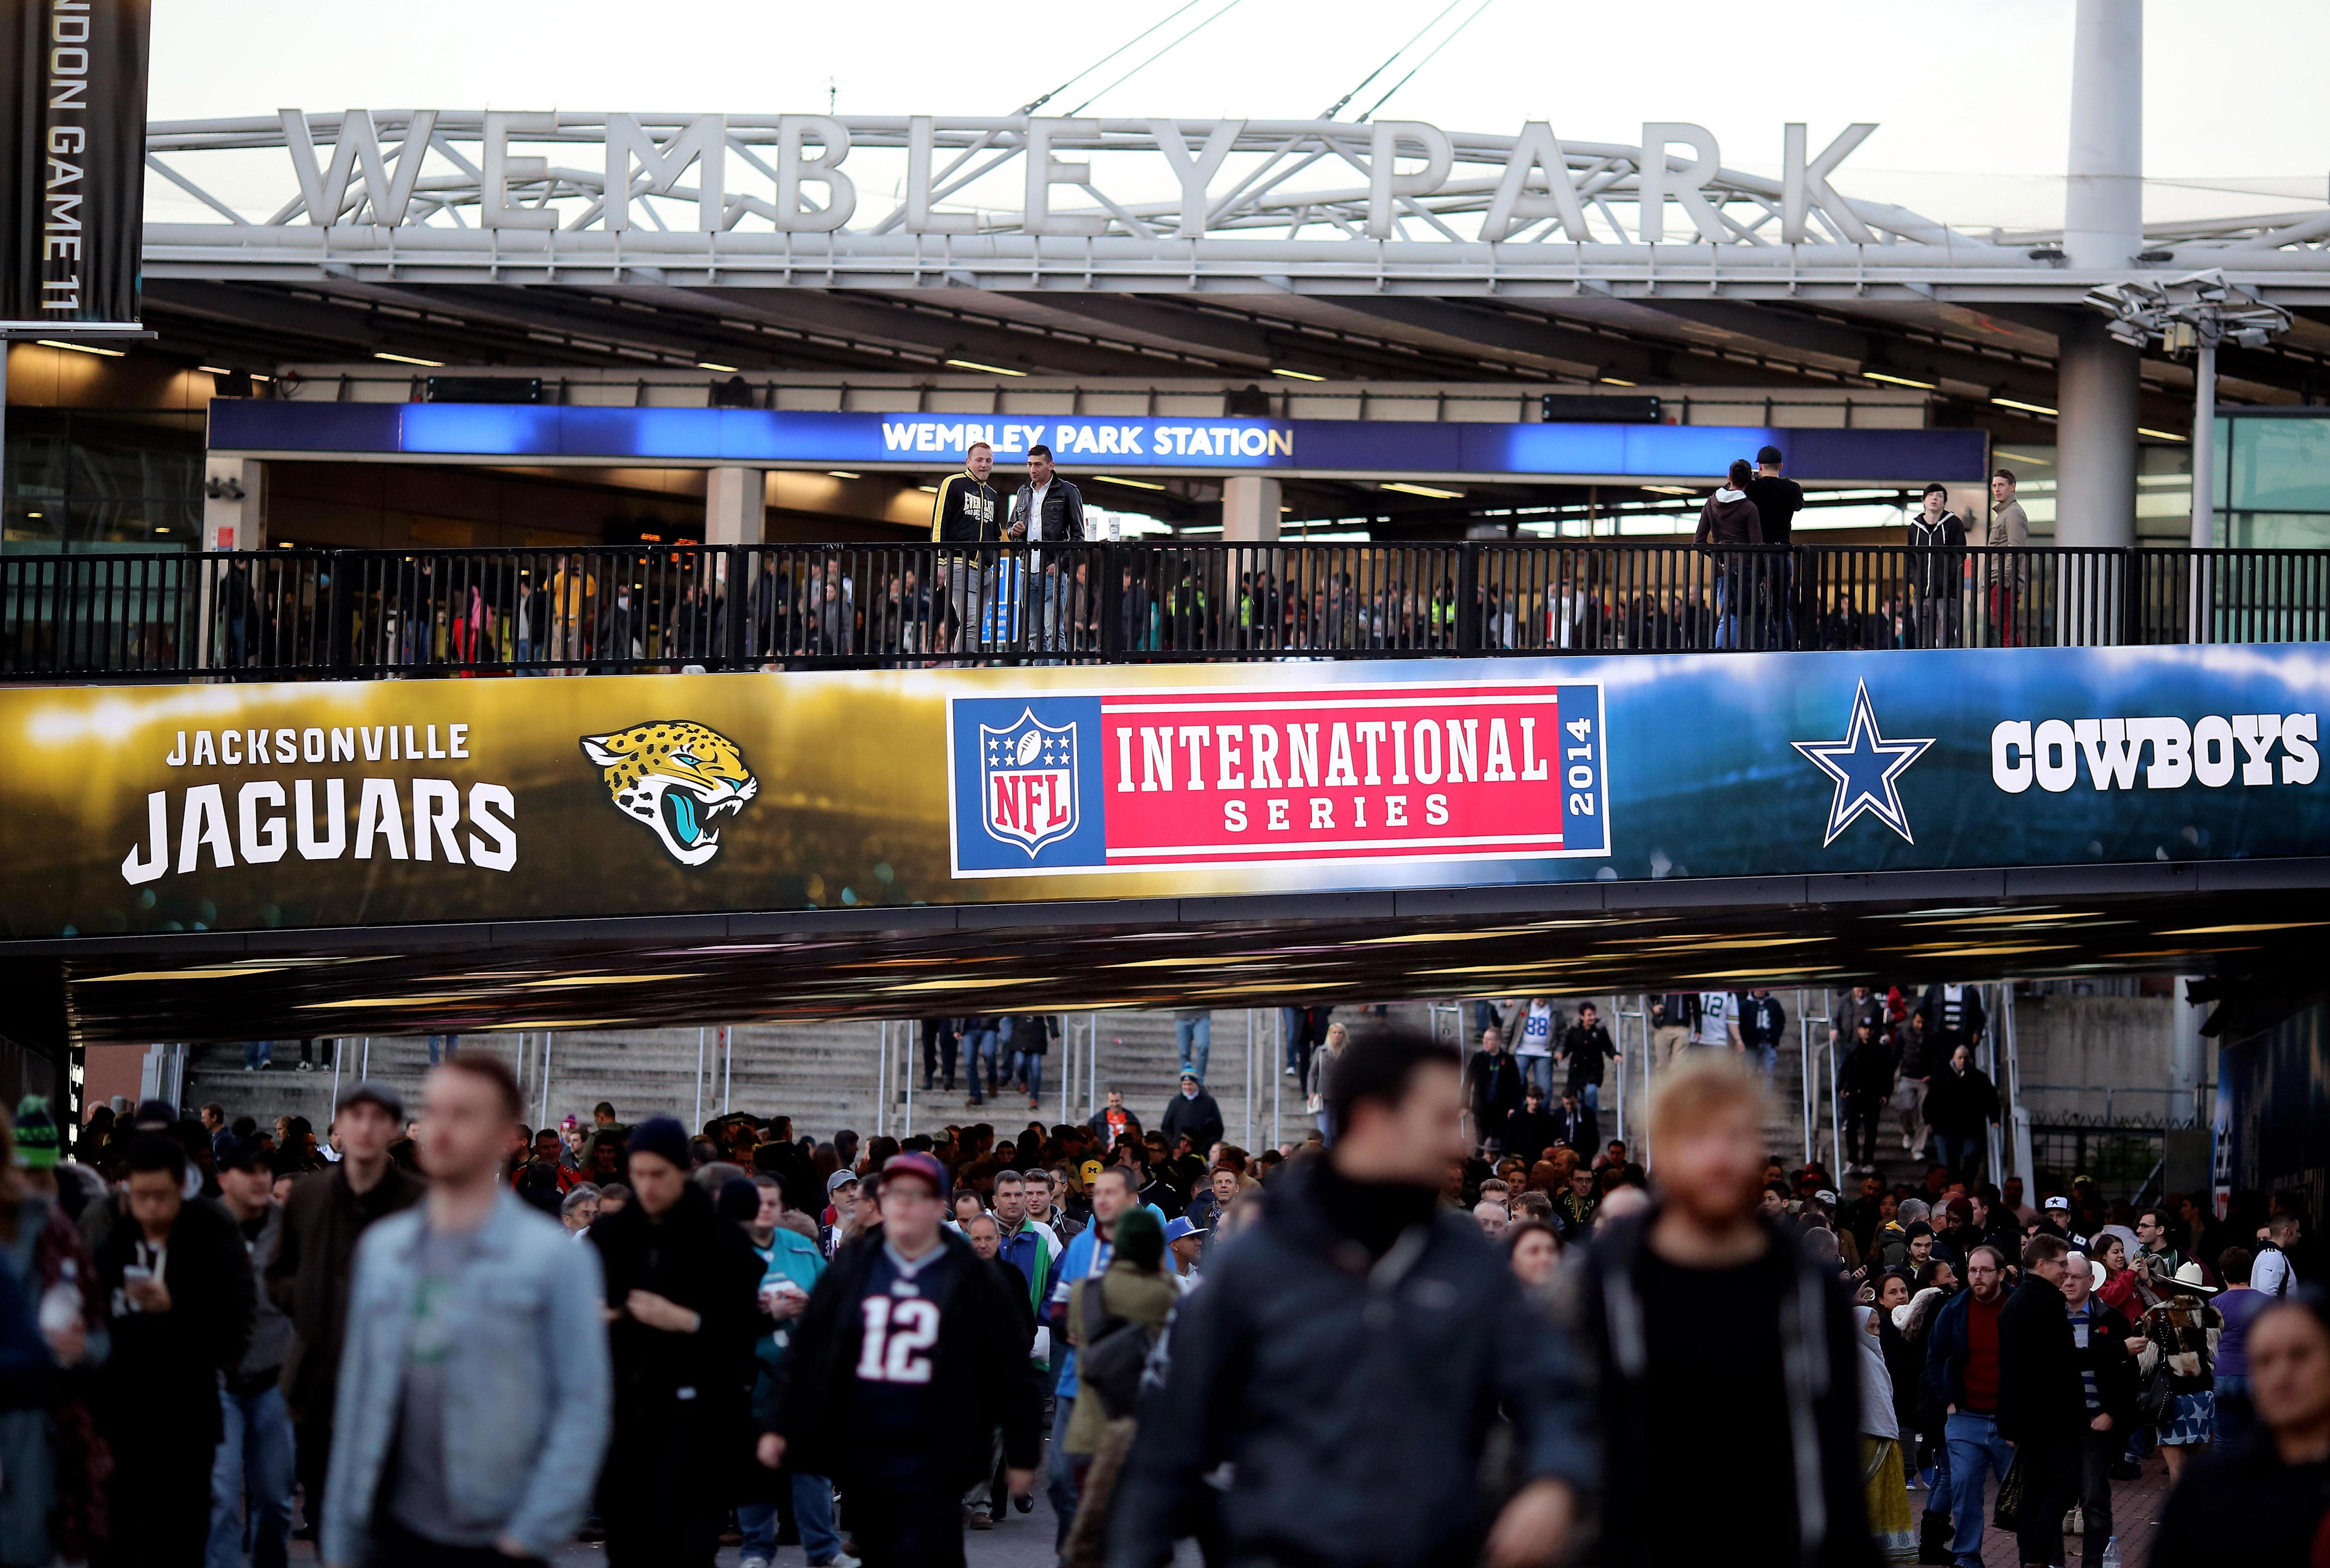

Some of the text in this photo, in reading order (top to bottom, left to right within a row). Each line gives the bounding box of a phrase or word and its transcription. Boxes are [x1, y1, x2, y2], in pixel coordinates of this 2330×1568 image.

[43, 125, 86, 262] GAME
[278, 108, 1880, 244] WEMBLEY PARK
[42, 275, 80, 309] 11
[881, 422, 1293, 456] WEMBLEY PARK STATION
[166, 723, 470, 766] JACKSONVILLE
[1116, 717, 1549, 792] INTERNATIONAL
[1566, 717, 1595, 816] 2014
[1991, 713, 2320, 793] COWBOYS
[121, 778, 518, 885] JAGUARS
[994, 774, 1067, 835] NFL
[1224, 793, 1450, 832] SERIES
[1526, 1017, 1548, 1036] 88
[1701, 994, 1723, 1017] 12
[857, 1294, 940, 1383] 12
